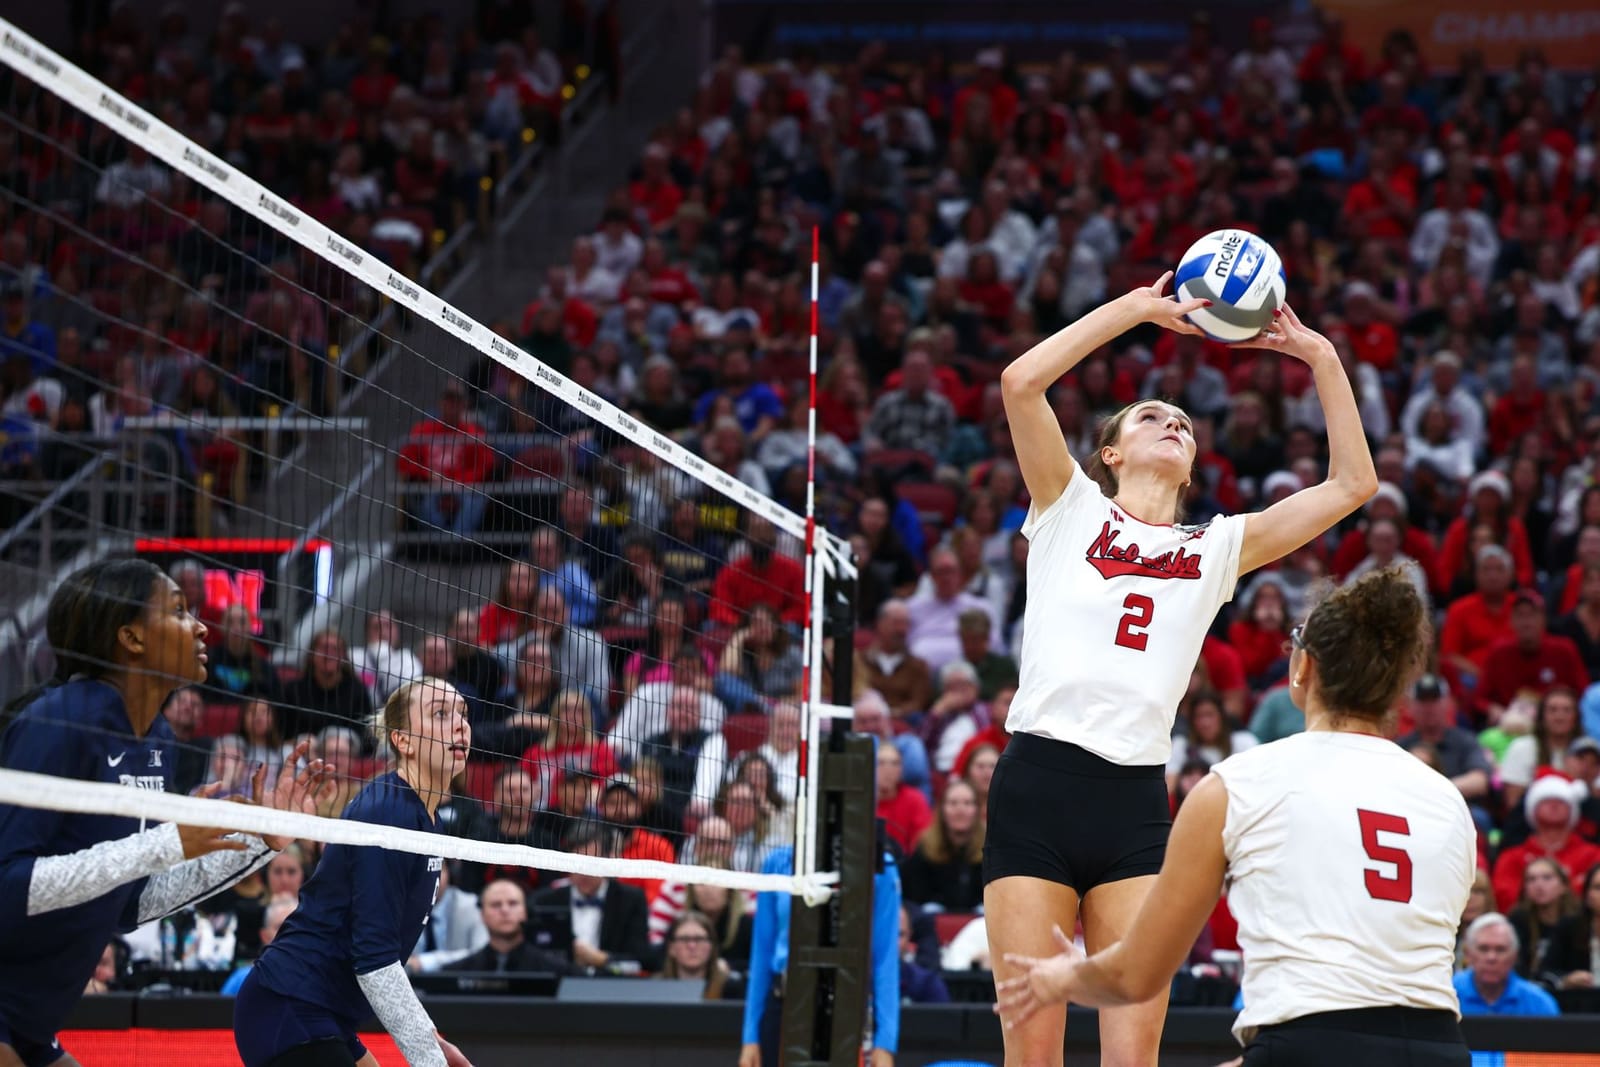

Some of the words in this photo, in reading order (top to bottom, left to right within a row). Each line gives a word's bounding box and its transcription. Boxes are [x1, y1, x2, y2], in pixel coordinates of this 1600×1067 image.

[1215, 232, 1242, 278] molte
[1114, 592, 1155, 652] 2
[1357, 808, 1413, 904] 5
